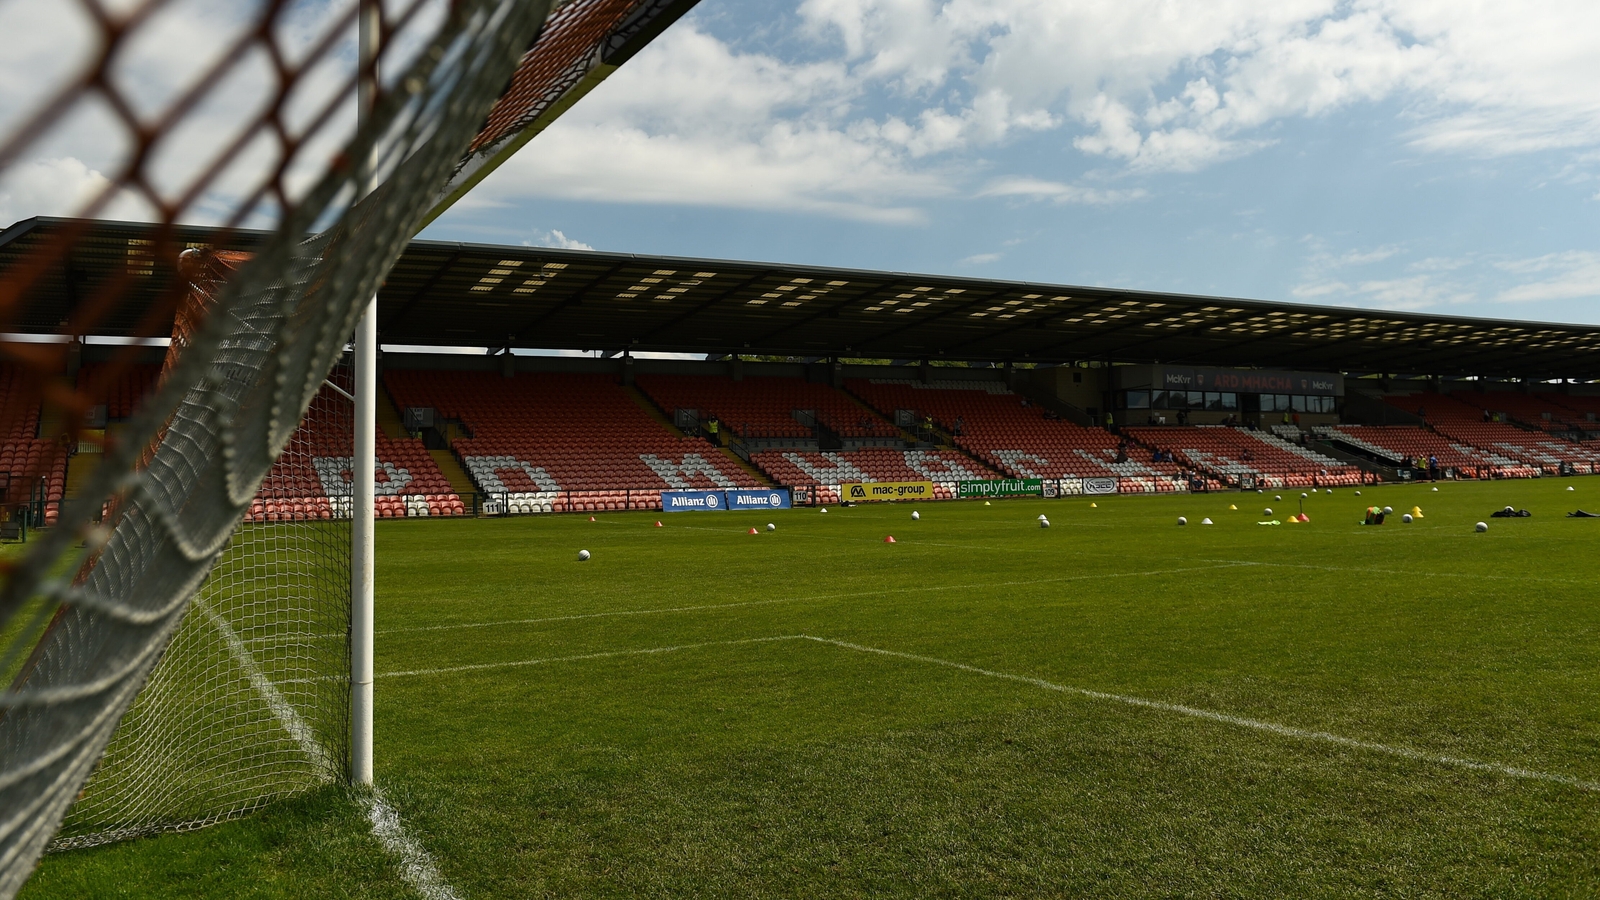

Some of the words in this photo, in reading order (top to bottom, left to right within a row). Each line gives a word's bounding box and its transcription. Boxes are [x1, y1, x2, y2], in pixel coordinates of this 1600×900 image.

[1214, 374, 1239, 388] ARD
[1242, 375, 1293, 390] MHACHA
[872, 485, 925, 496] mac-group
[960, 479, 1041, 495] simplyfruit.com
[671, 496, 704, 507] Allianz
[737, 495, 768, 505] Allianz
[794, 492, 807, 501] 110
[485, 503, 499, 513] 111
